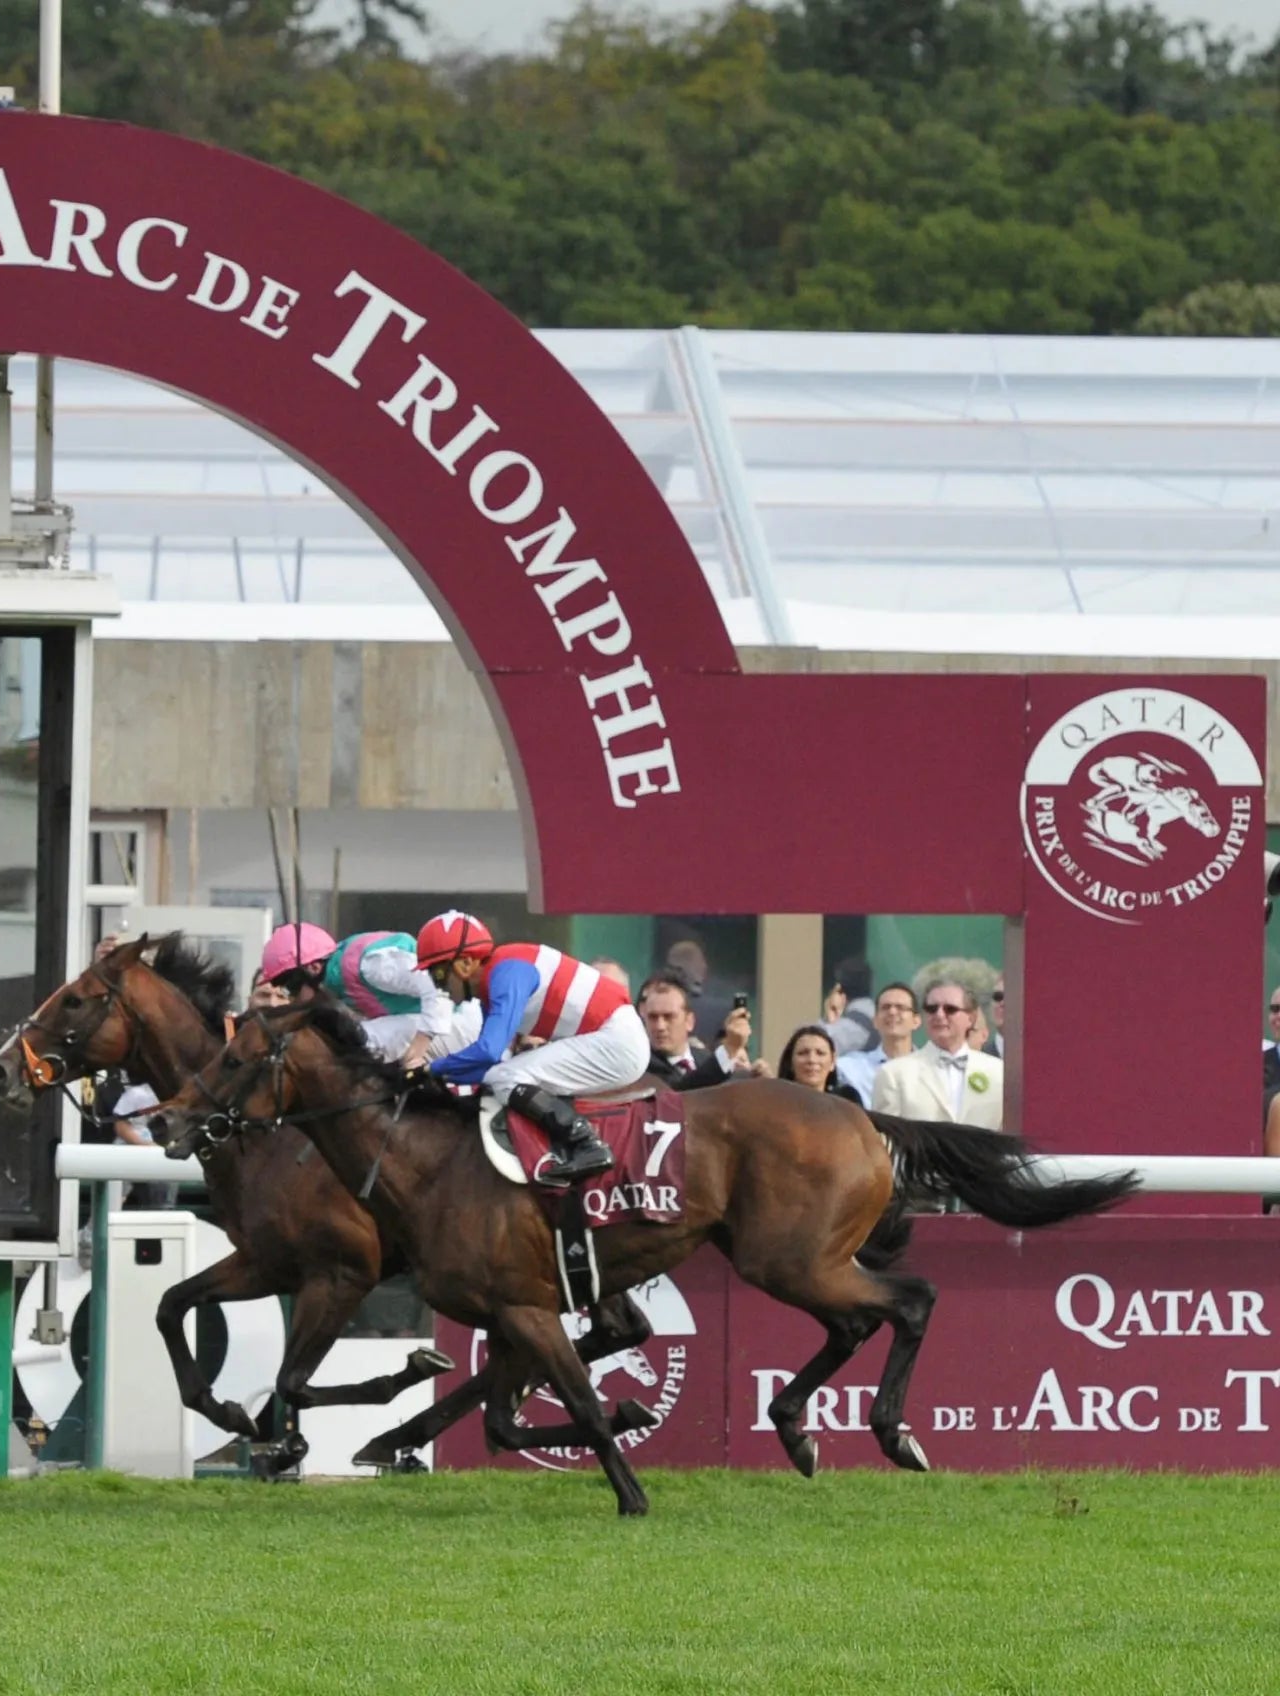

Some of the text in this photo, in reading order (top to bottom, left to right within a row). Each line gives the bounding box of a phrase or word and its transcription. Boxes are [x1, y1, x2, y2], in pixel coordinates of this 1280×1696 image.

[186, 251, 300, 340] DE
[312, 270, 681, 808] TRIOMPHE
[1060, 697, 1225, 752] QATAR
[1035, 796, 1064, 856] PRIX
[1058, 853, 1079, 876] DE
[1140, 892, 1162, 906] DE
[1165, 795, 1251, 906] TRIOMPHE
[643, 1119, 682, 1177] 7
[583, 1181, 681, 1220] QATAR
[1055, 1273, 1272, 1350] QATAR
[750, 1368, 912, 1431] PRI
[932, 1406, 977, 1431] DE
[1178, 1407, 1222, 1432] DE
